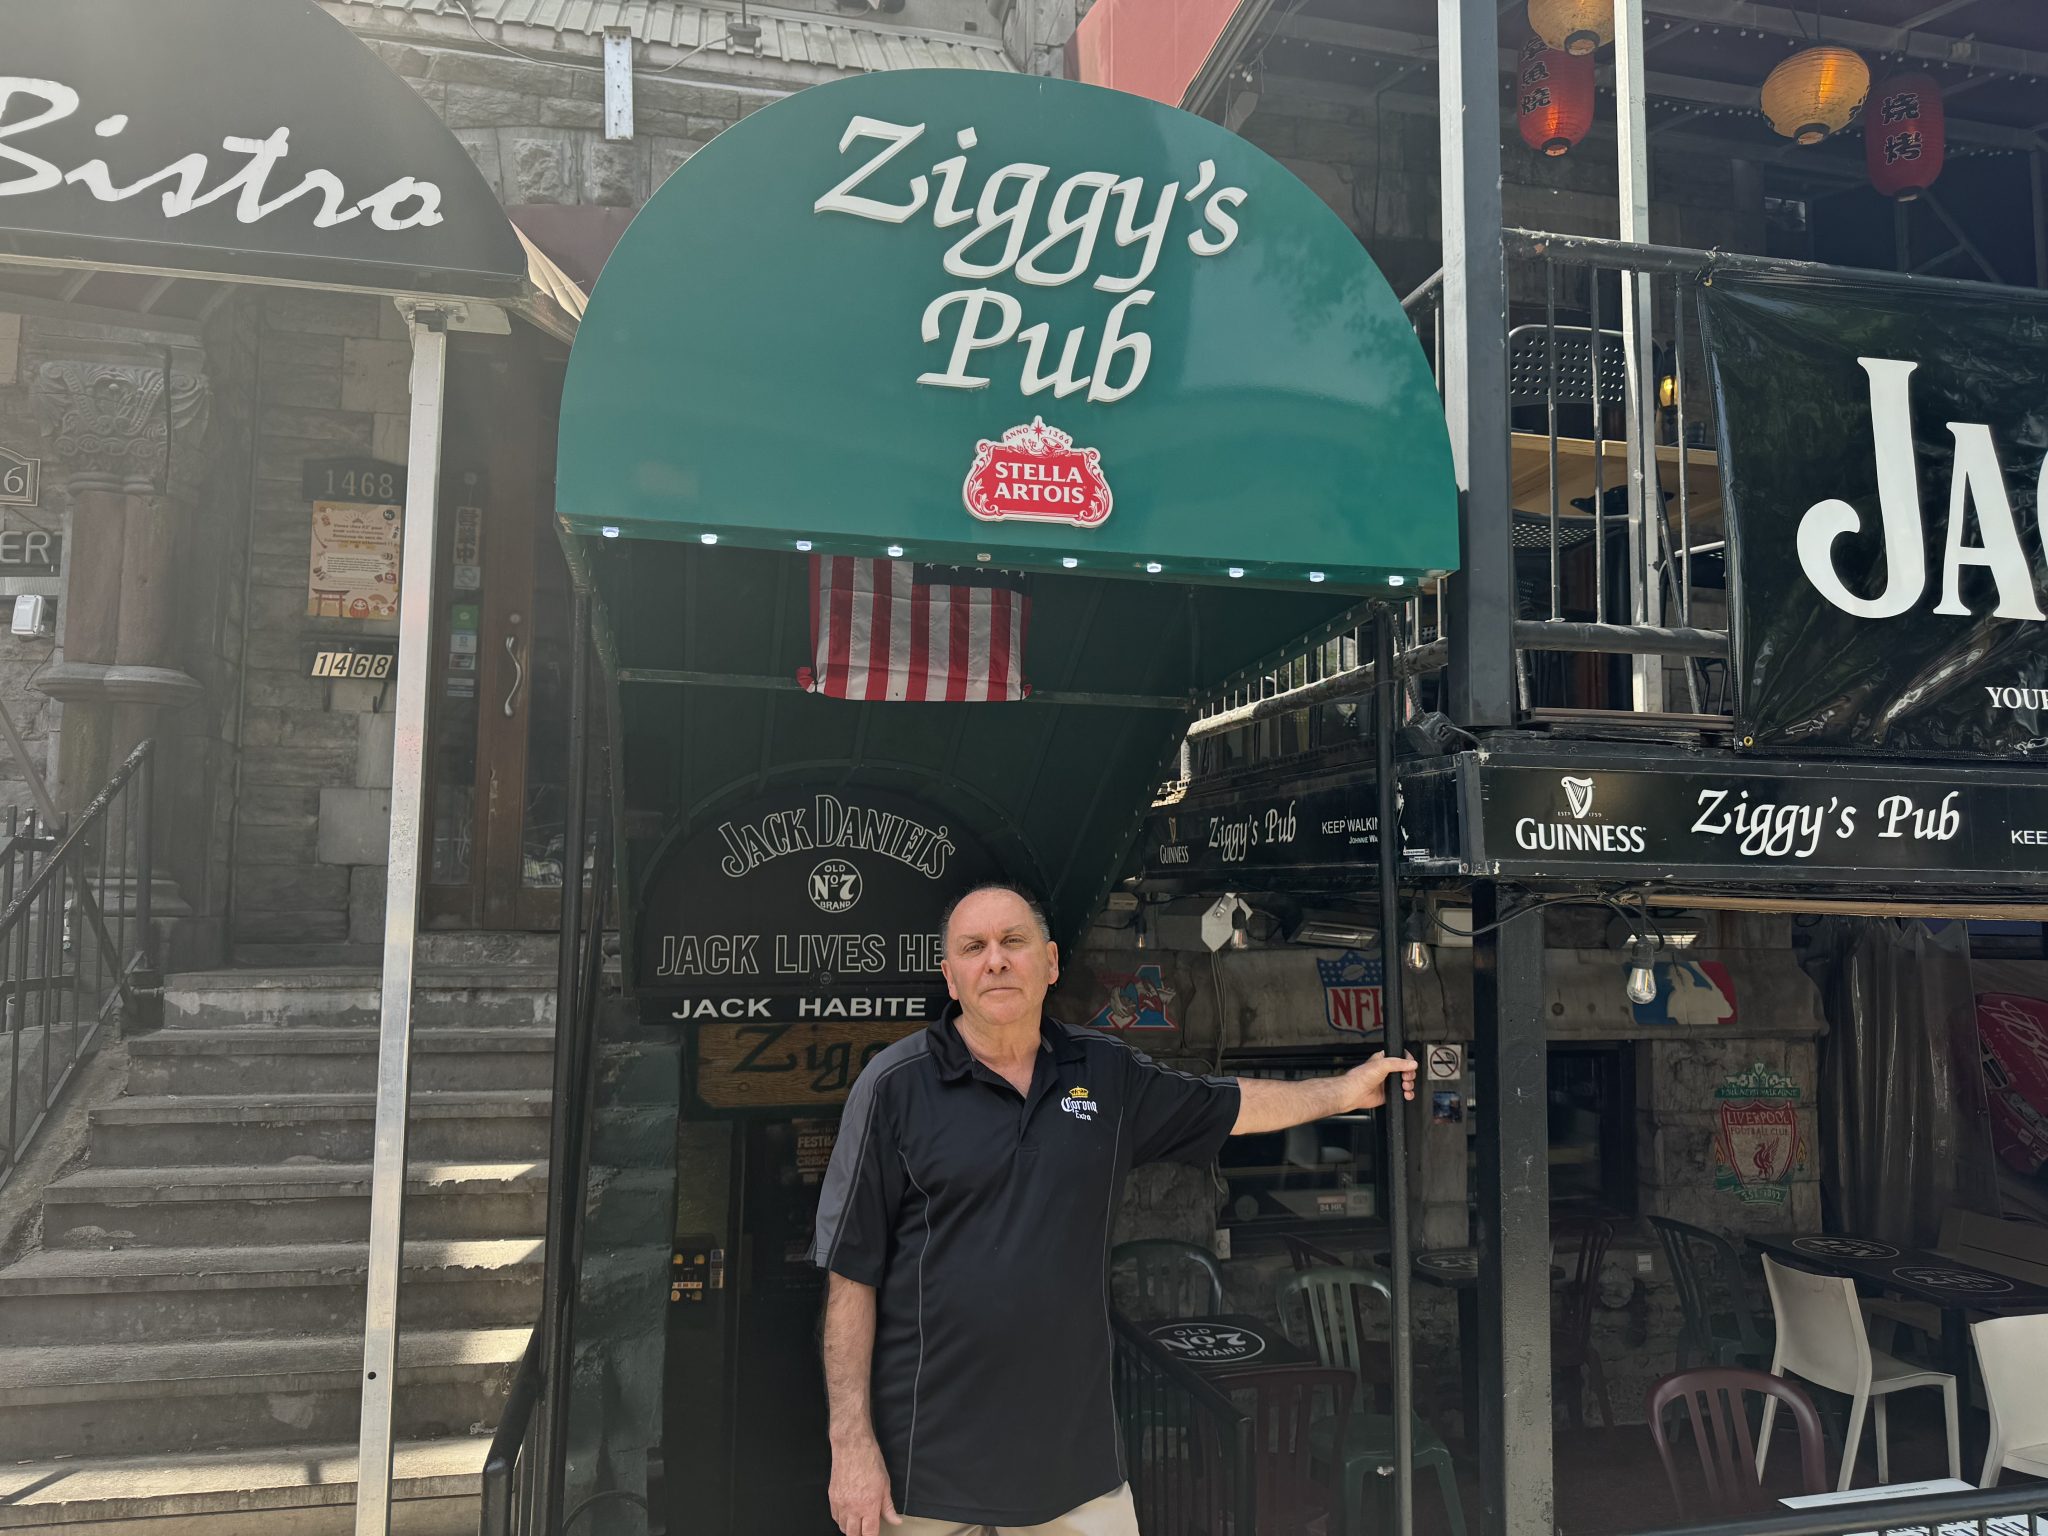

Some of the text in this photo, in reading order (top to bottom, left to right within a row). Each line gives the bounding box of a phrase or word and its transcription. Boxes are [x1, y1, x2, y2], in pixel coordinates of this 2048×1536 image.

[0, 76, 444, 231] Bistro
[813, 115, 1248, 293] Ziggy's
[916, 287, 1155, 402] Pub
[1005, 427, 1070, 444] ANNO 1366
[995, 461, 1084, 484] STELLA
[325, 470, 394, 499] 1468
[994, 482, 1085, 504] ARTOIS
[1796, 356, 2048, 621] JA
[0, 531, 63, 564] ER
[316, 653, 390, 677] 1468
[1208, 800, 1297, 863] Ziggy's Pub
[1321, 819, 1346, 835] KEEP
[1515, 817, 1647, 853] GUINNESS
[1691, 789, 1960, 858] Ziggy's Pub
[718, 794, 956, 879] JACK DANIEL'S
[2011, 830, 2048, 845] KEE
[1159, 844, 1189, 864] GUINNESS
[824, 864, 846, 873] OLD
[819, 900, 851, 911] BRAND
[657, 934, 759, 976] JACK
[776, 934, 886, 973] LIVES
[672, 997, 926, 1019] JACK HABITE
[1330, 987, 1384, 1031] NFL
[1061, 1097, 1098, 1113] Corona
[1075, 1110, 1091, 1120] Extra
[1727, 1110, 1790, 1125] LIVERPOOL
[797, 1136, 836, 1148] FESTIV
